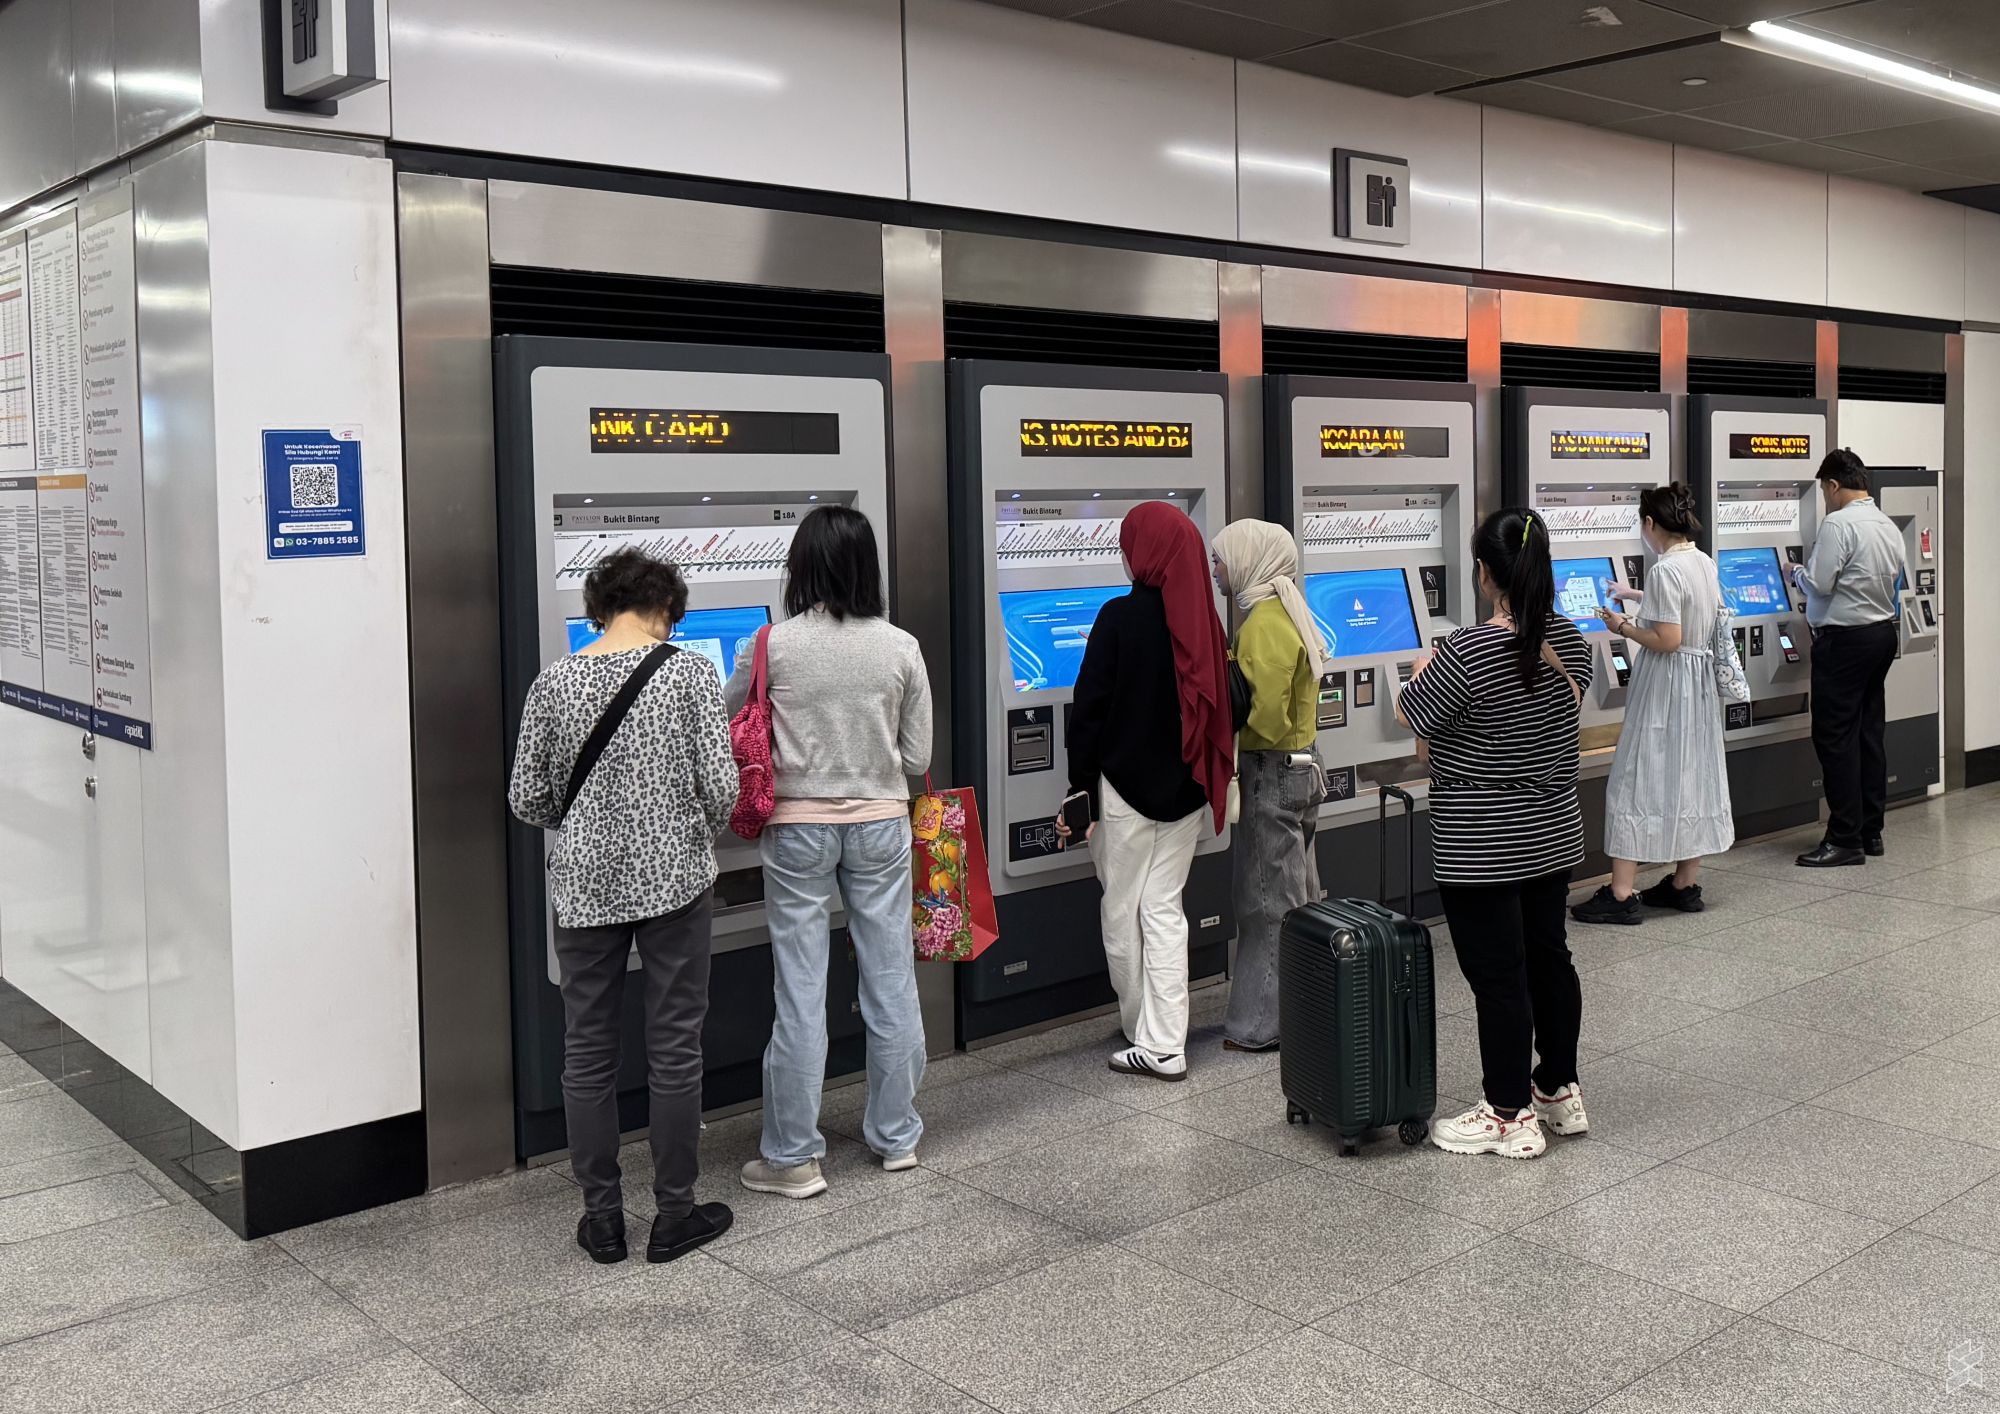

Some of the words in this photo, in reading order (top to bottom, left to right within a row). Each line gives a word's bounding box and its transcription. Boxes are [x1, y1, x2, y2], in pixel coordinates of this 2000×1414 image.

[1051, 423, 1120, 447] NOTES
[1124, 424, 1164, 447] AND
[604, 515, 626, 523] Bukit
[628, 514, 660, 524] Bintang
[296, 537, 334, 545] 03-7885
[124, 725, 144, 739] rapidKL
